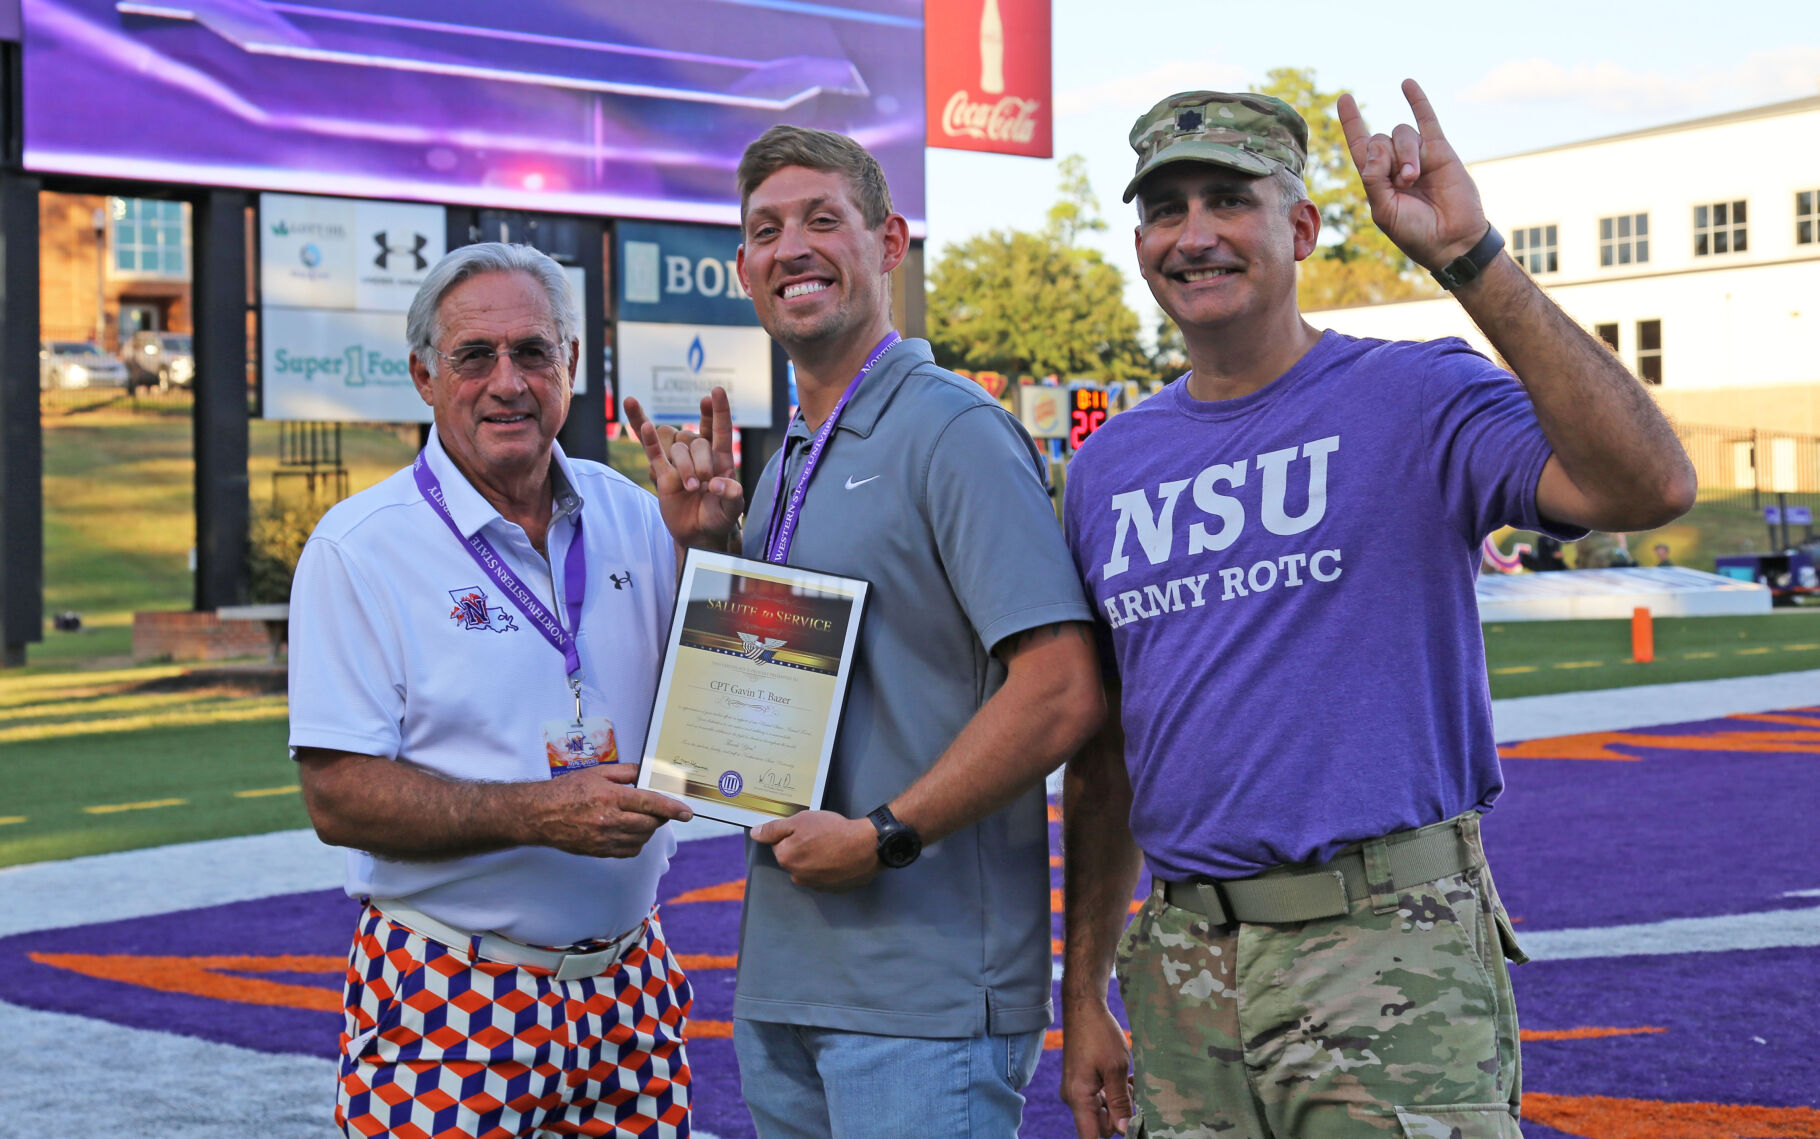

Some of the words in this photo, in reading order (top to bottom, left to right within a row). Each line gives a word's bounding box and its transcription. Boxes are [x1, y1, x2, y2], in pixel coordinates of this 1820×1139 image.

[942, 90, 1039, 143] Coca-Cola
[274, 349, 343, 380] Super
[344, 345, 366, 387] 1
[367, 351, 410, 376] Foo
[774, 505, 796, 561] WESTERN
[1102, 434, 1340, 581] NSU
[469, 535, 499, 569] STATE
[493, 565, 568, 646] NORTHWESTERN
[705, 597, 758, 616] SALUTE
[776, 610, 832, 632] SERVICE
[1103, 573, 1210, 630] ARMY
[1218, 548, 1343, 601] ROTC
[710, 680, 730, 692] CPT
[730, 684, 755, 698] Gavin
[767, 691, 792, 705] Bazer
